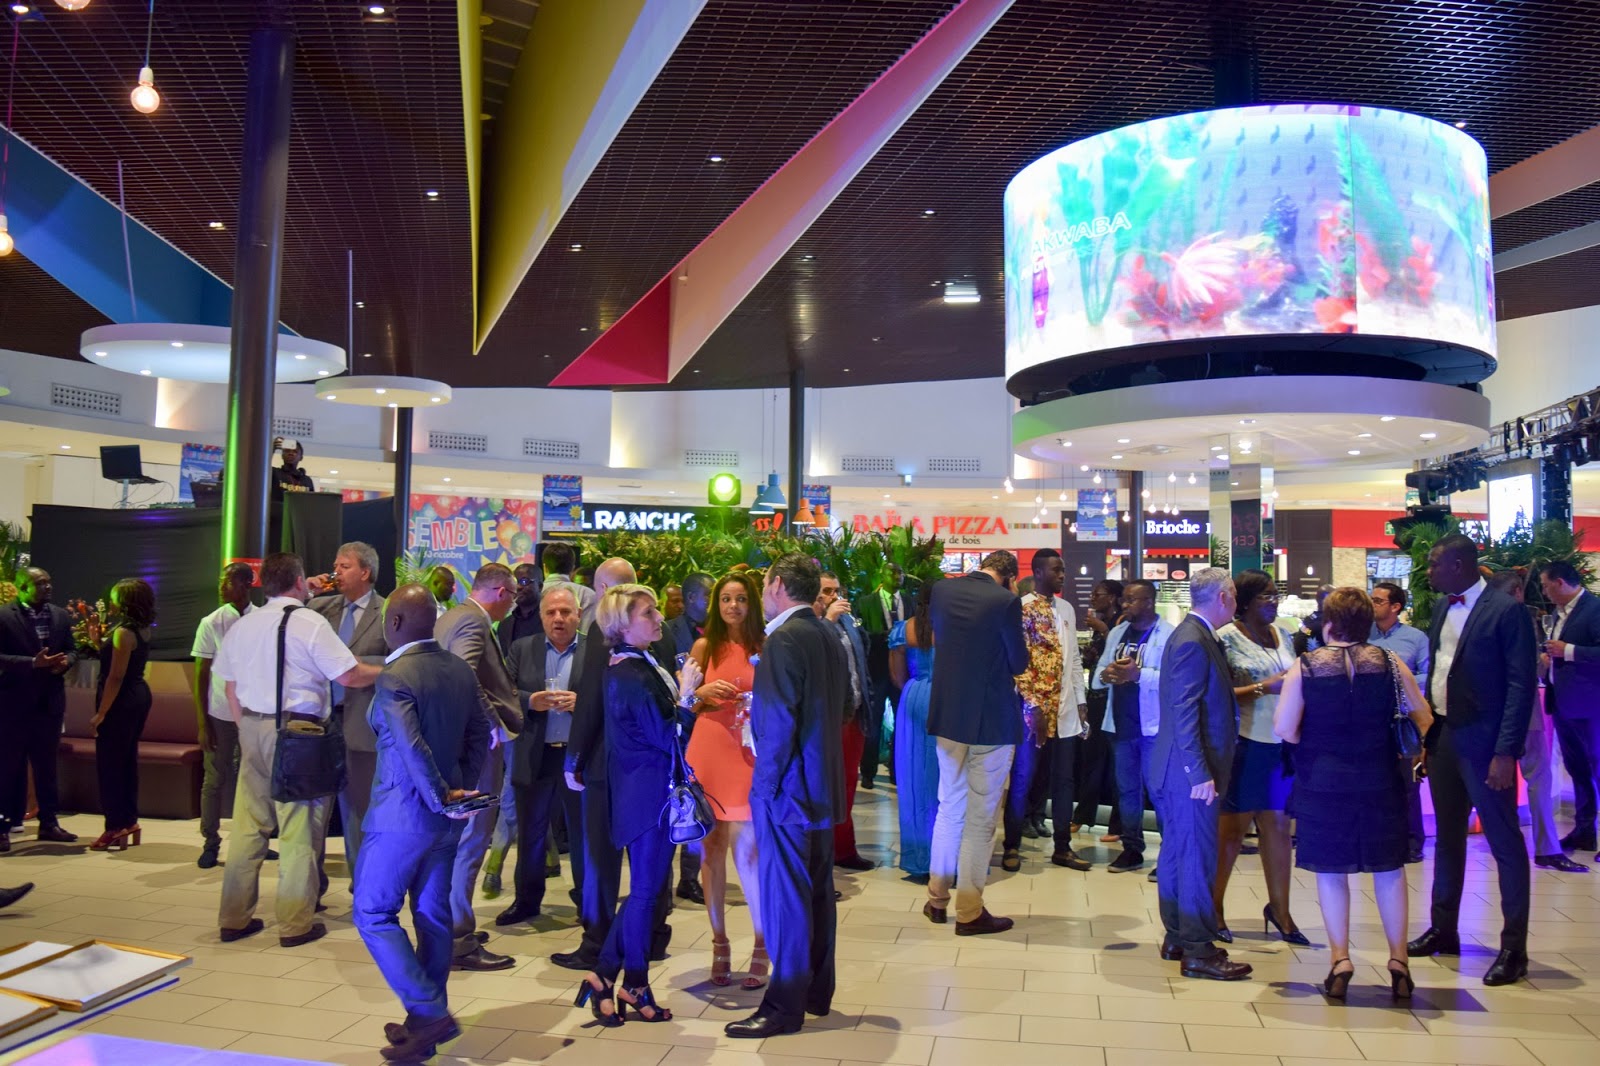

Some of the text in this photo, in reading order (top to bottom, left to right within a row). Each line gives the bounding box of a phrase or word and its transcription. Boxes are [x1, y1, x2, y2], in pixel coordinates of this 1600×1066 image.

[1032, 211, 1132, 253] AKWABA
[581, 510, 592, 529] L
[932, 516, 1008, 535] PIZZA
[1146, 519, 1200, 534] Brioche
[949, 535, 959, 544] de
[962, 535, 981, 544] bois
[433, 551, 464, 559] octobre
